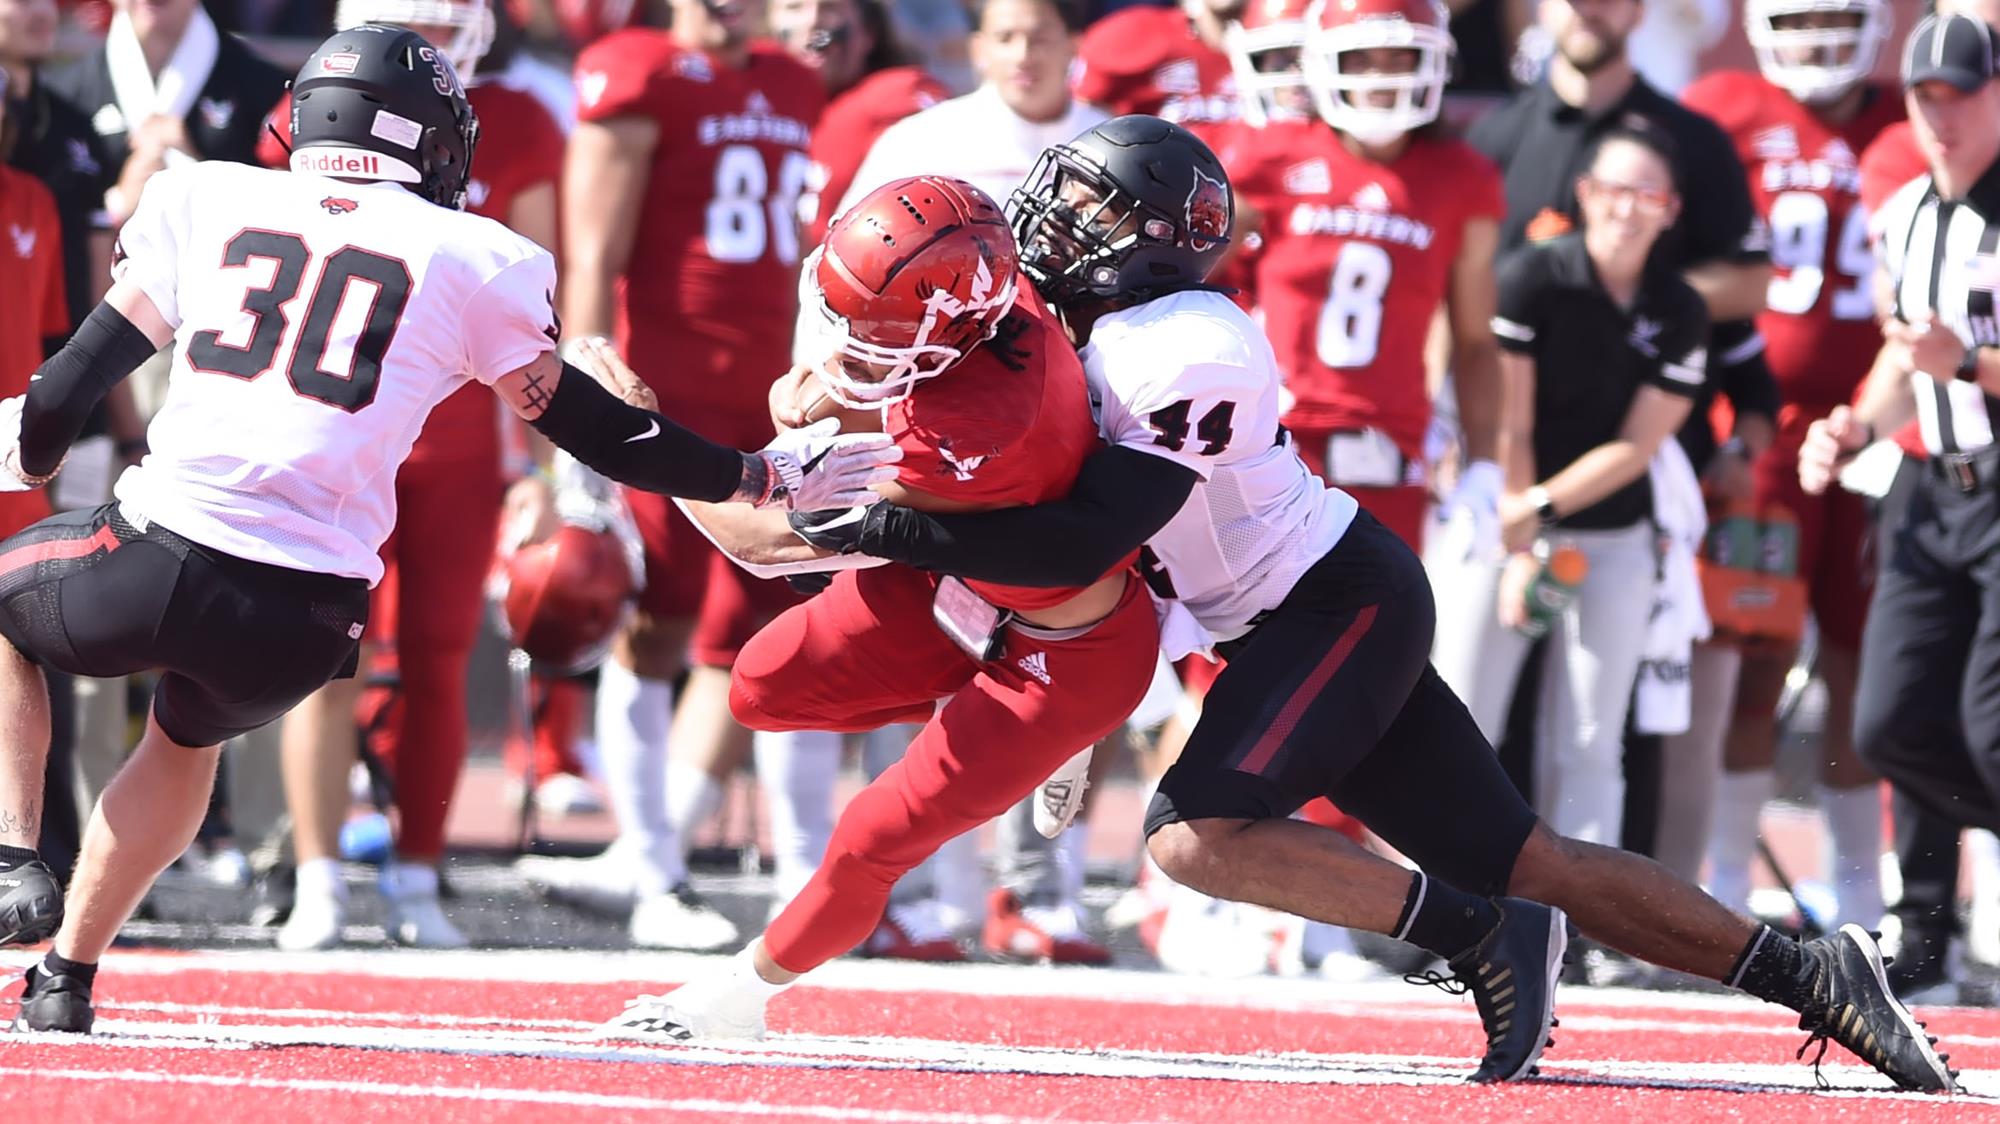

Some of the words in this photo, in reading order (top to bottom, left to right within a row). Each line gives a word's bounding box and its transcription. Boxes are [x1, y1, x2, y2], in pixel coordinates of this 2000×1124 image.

[300, 154, 379, 174] Riddell
[1290, 203, 1435, 250] EASTERN
[186, 227, 414, 414] 30
[1317, 241, 1393, 369] 8
[1149, 399, 1237, 456] 44
